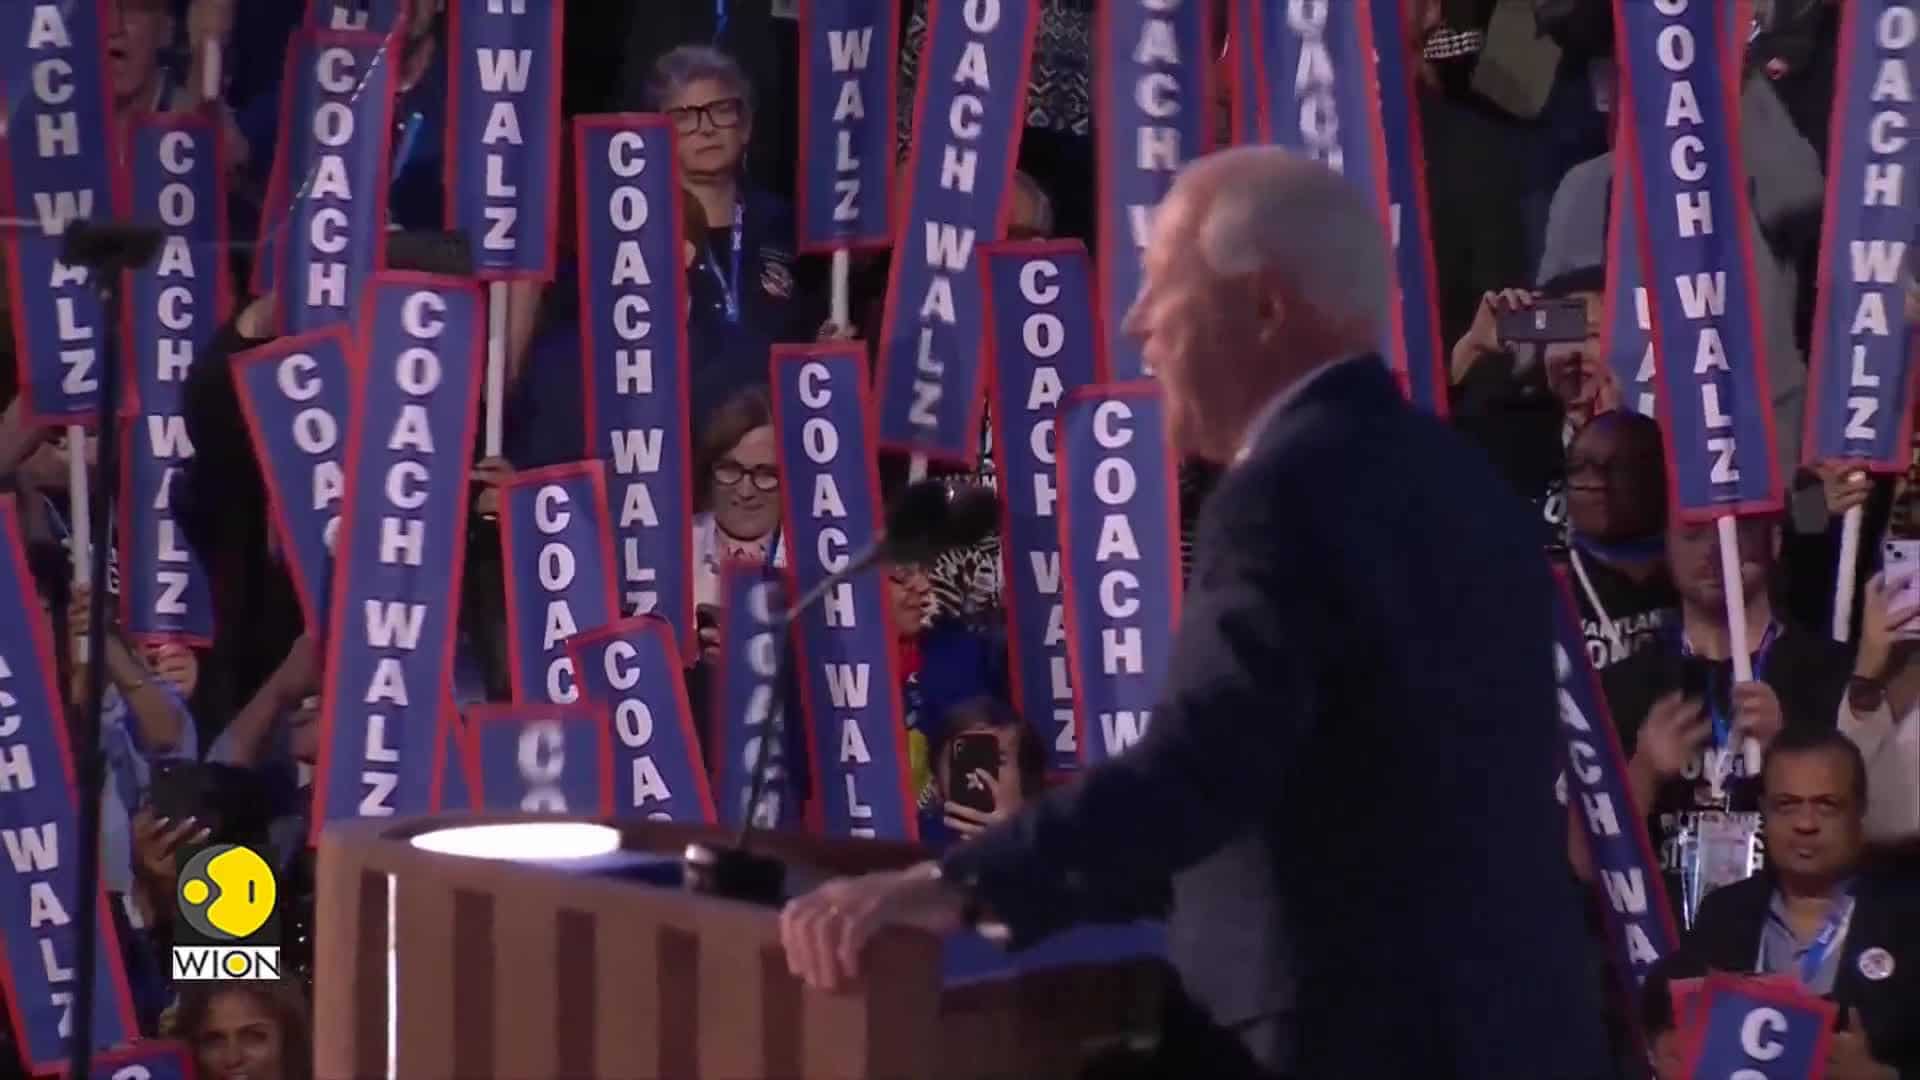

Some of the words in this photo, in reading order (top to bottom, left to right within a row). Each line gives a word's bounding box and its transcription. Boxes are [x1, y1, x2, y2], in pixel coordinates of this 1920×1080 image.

[307, 48, 357, 307] COACH
[476, 48, 532, 250] WALZ
[828, 27, 873, 222] WALZ
[1136, 0, 1181, 169] ACH
[1863, 8, 1918, 206] OACH
[158, 131, 196, 382] COACH
[608, 131, 653, 394] COACH
[909, 221, 975, 427] WALZ
[1845, 241, 1906, 440] WALZ
[277, 353, 345, 558] COA
[379, 291, 447, 567] COACH
[1675, 272, 1740, 483] WALZ
[799, 362, 856, 629] COACH
[1093, 400, 1141, 675] COACH
[359, 600, 426, 817] WALZ
[603, 639, 673, 821] COA
[825, 663, 876, 838] WAL
